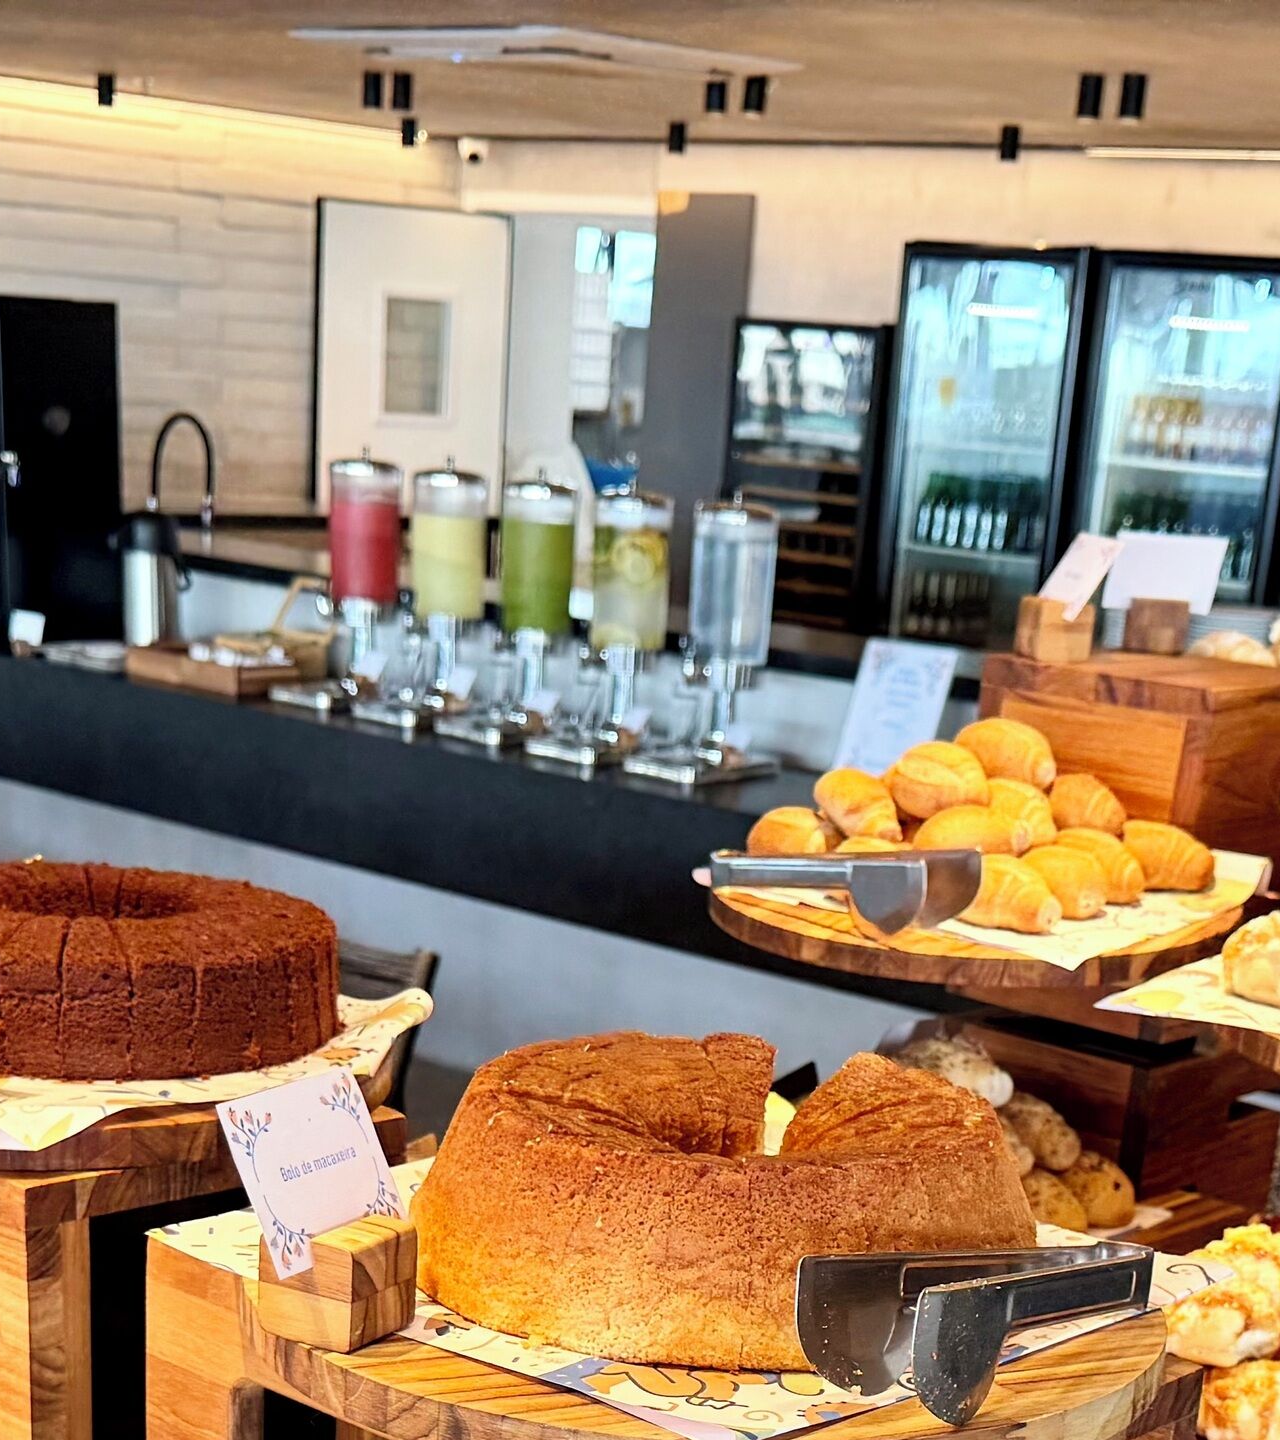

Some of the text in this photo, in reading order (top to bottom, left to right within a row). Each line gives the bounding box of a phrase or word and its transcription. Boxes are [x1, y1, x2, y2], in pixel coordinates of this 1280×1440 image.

[279, 1146, 357, 1182] Bolo de macaxeira
